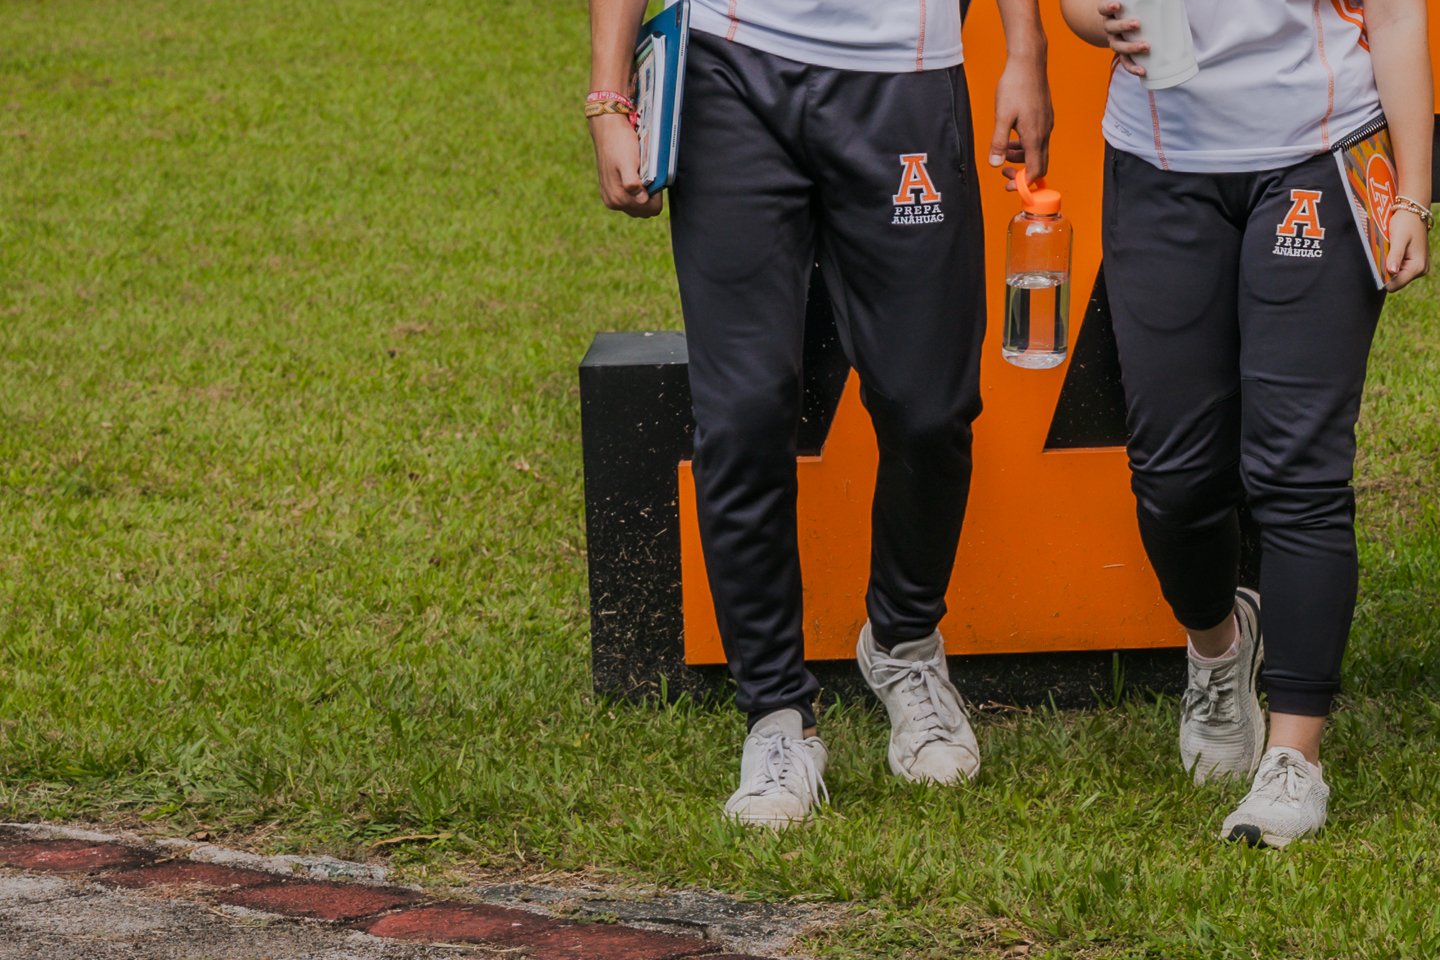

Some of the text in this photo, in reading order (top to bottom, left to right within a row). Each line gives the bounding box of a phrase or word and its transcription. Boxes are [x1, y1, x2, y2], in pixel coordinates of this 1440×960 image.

[892, 152, 942, 206] A
[894, 203, 942, 215] PREPA
[1276, 188, 1326, 240] A
[1275, 236, 1321, 249] PREPA
